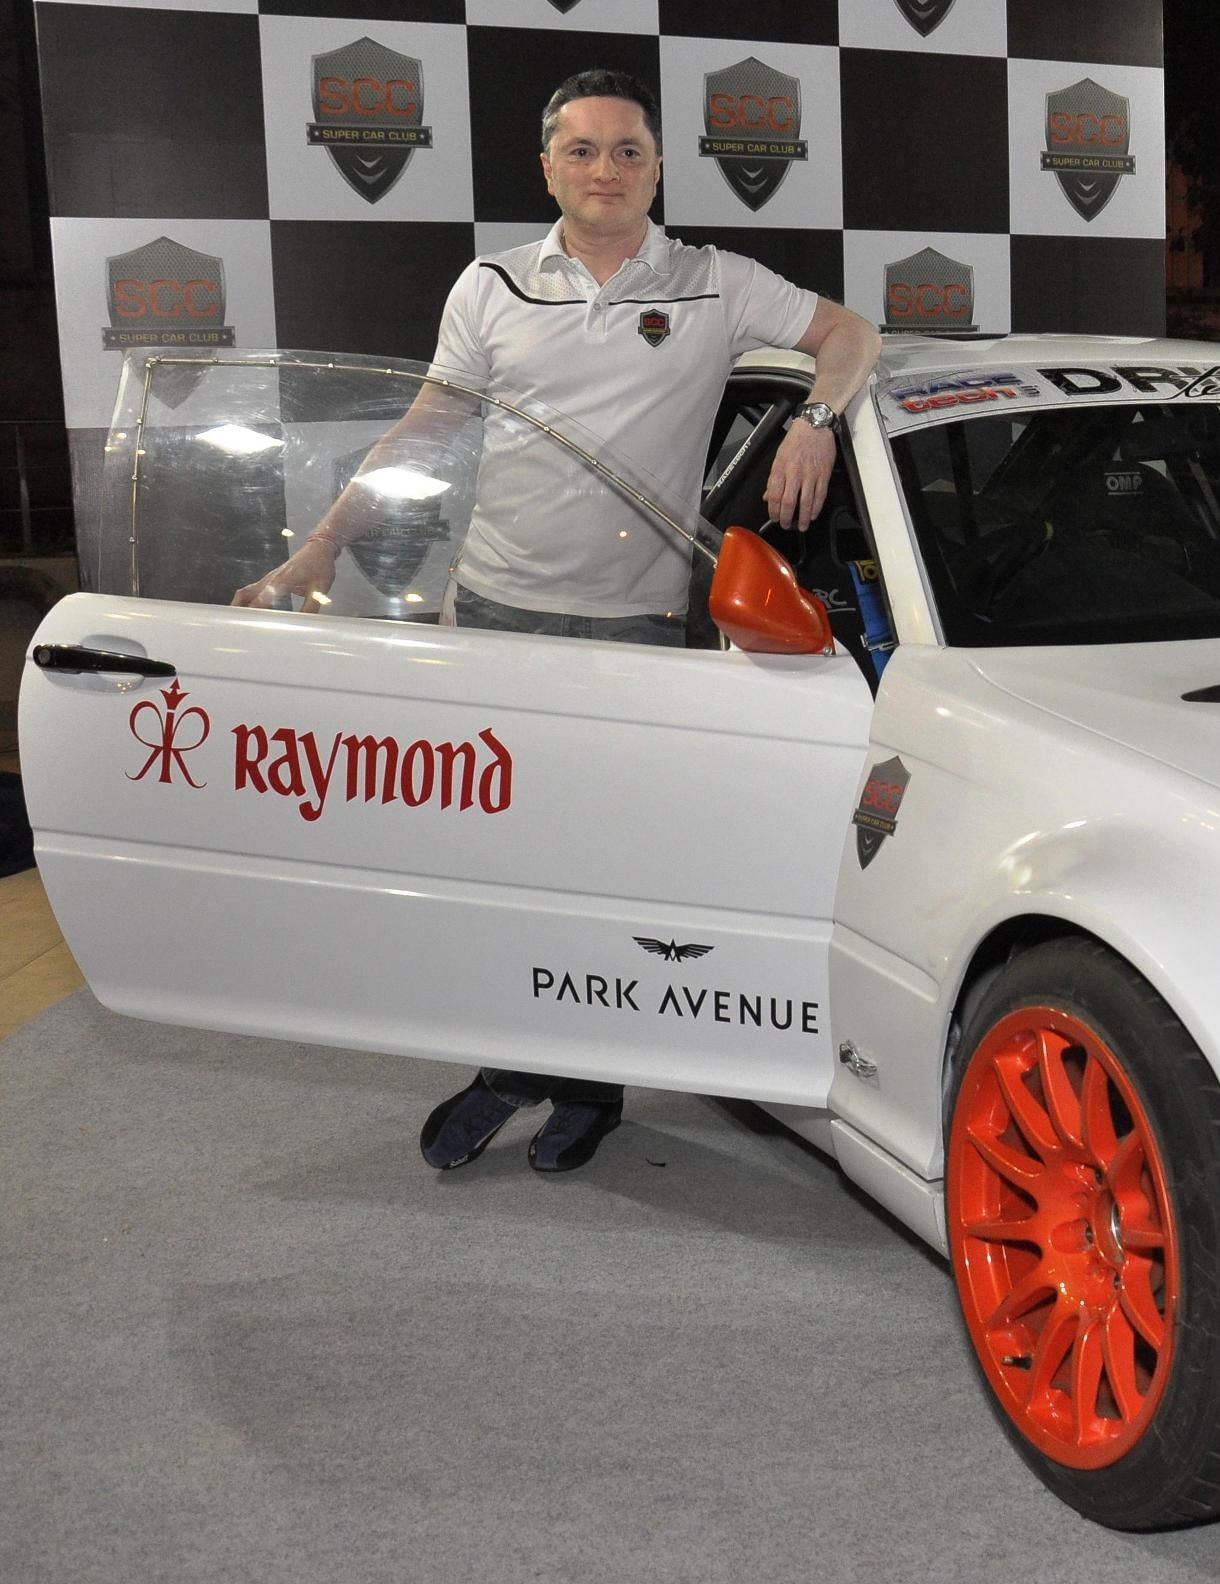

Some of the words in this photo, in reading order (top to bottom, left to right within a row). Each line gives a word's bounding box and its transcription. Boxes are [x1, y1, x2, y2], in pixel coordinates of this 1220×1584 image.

[319, 76, 417, 116] SCC
[709, 93, 796, 132] SCC
[322, 129, 359, 139] SUPER
[362, 131, 385, 140] CAR
[388, 132, 417, 141] CLUB
[1050, 111, 1125, 147] SCC
[712, 142, 744, 152] SUPER
[747, 144, 767, 153] CAR
[769, 145, 795, 154] CLUB
[1052, 157, 1080, 166] SUPER
[1082, 158, 1100, 167] CAR
[1102, 159, 1124, 168] CLUB
[114, 279, 217, 318] SCC
[889, 283, 968, 318] SCC
[119, 333, 158, 343] SUPER
[161, 333, 186, 343] CAR
[189, 333, 220, 342] CLUB
[1106, 475, 1143, 491] OMP
[231, 723, 513, 822] Raymond
[532, 967, 640, 1011] PARK
[658, 984, 819, 1034] AVENUE
